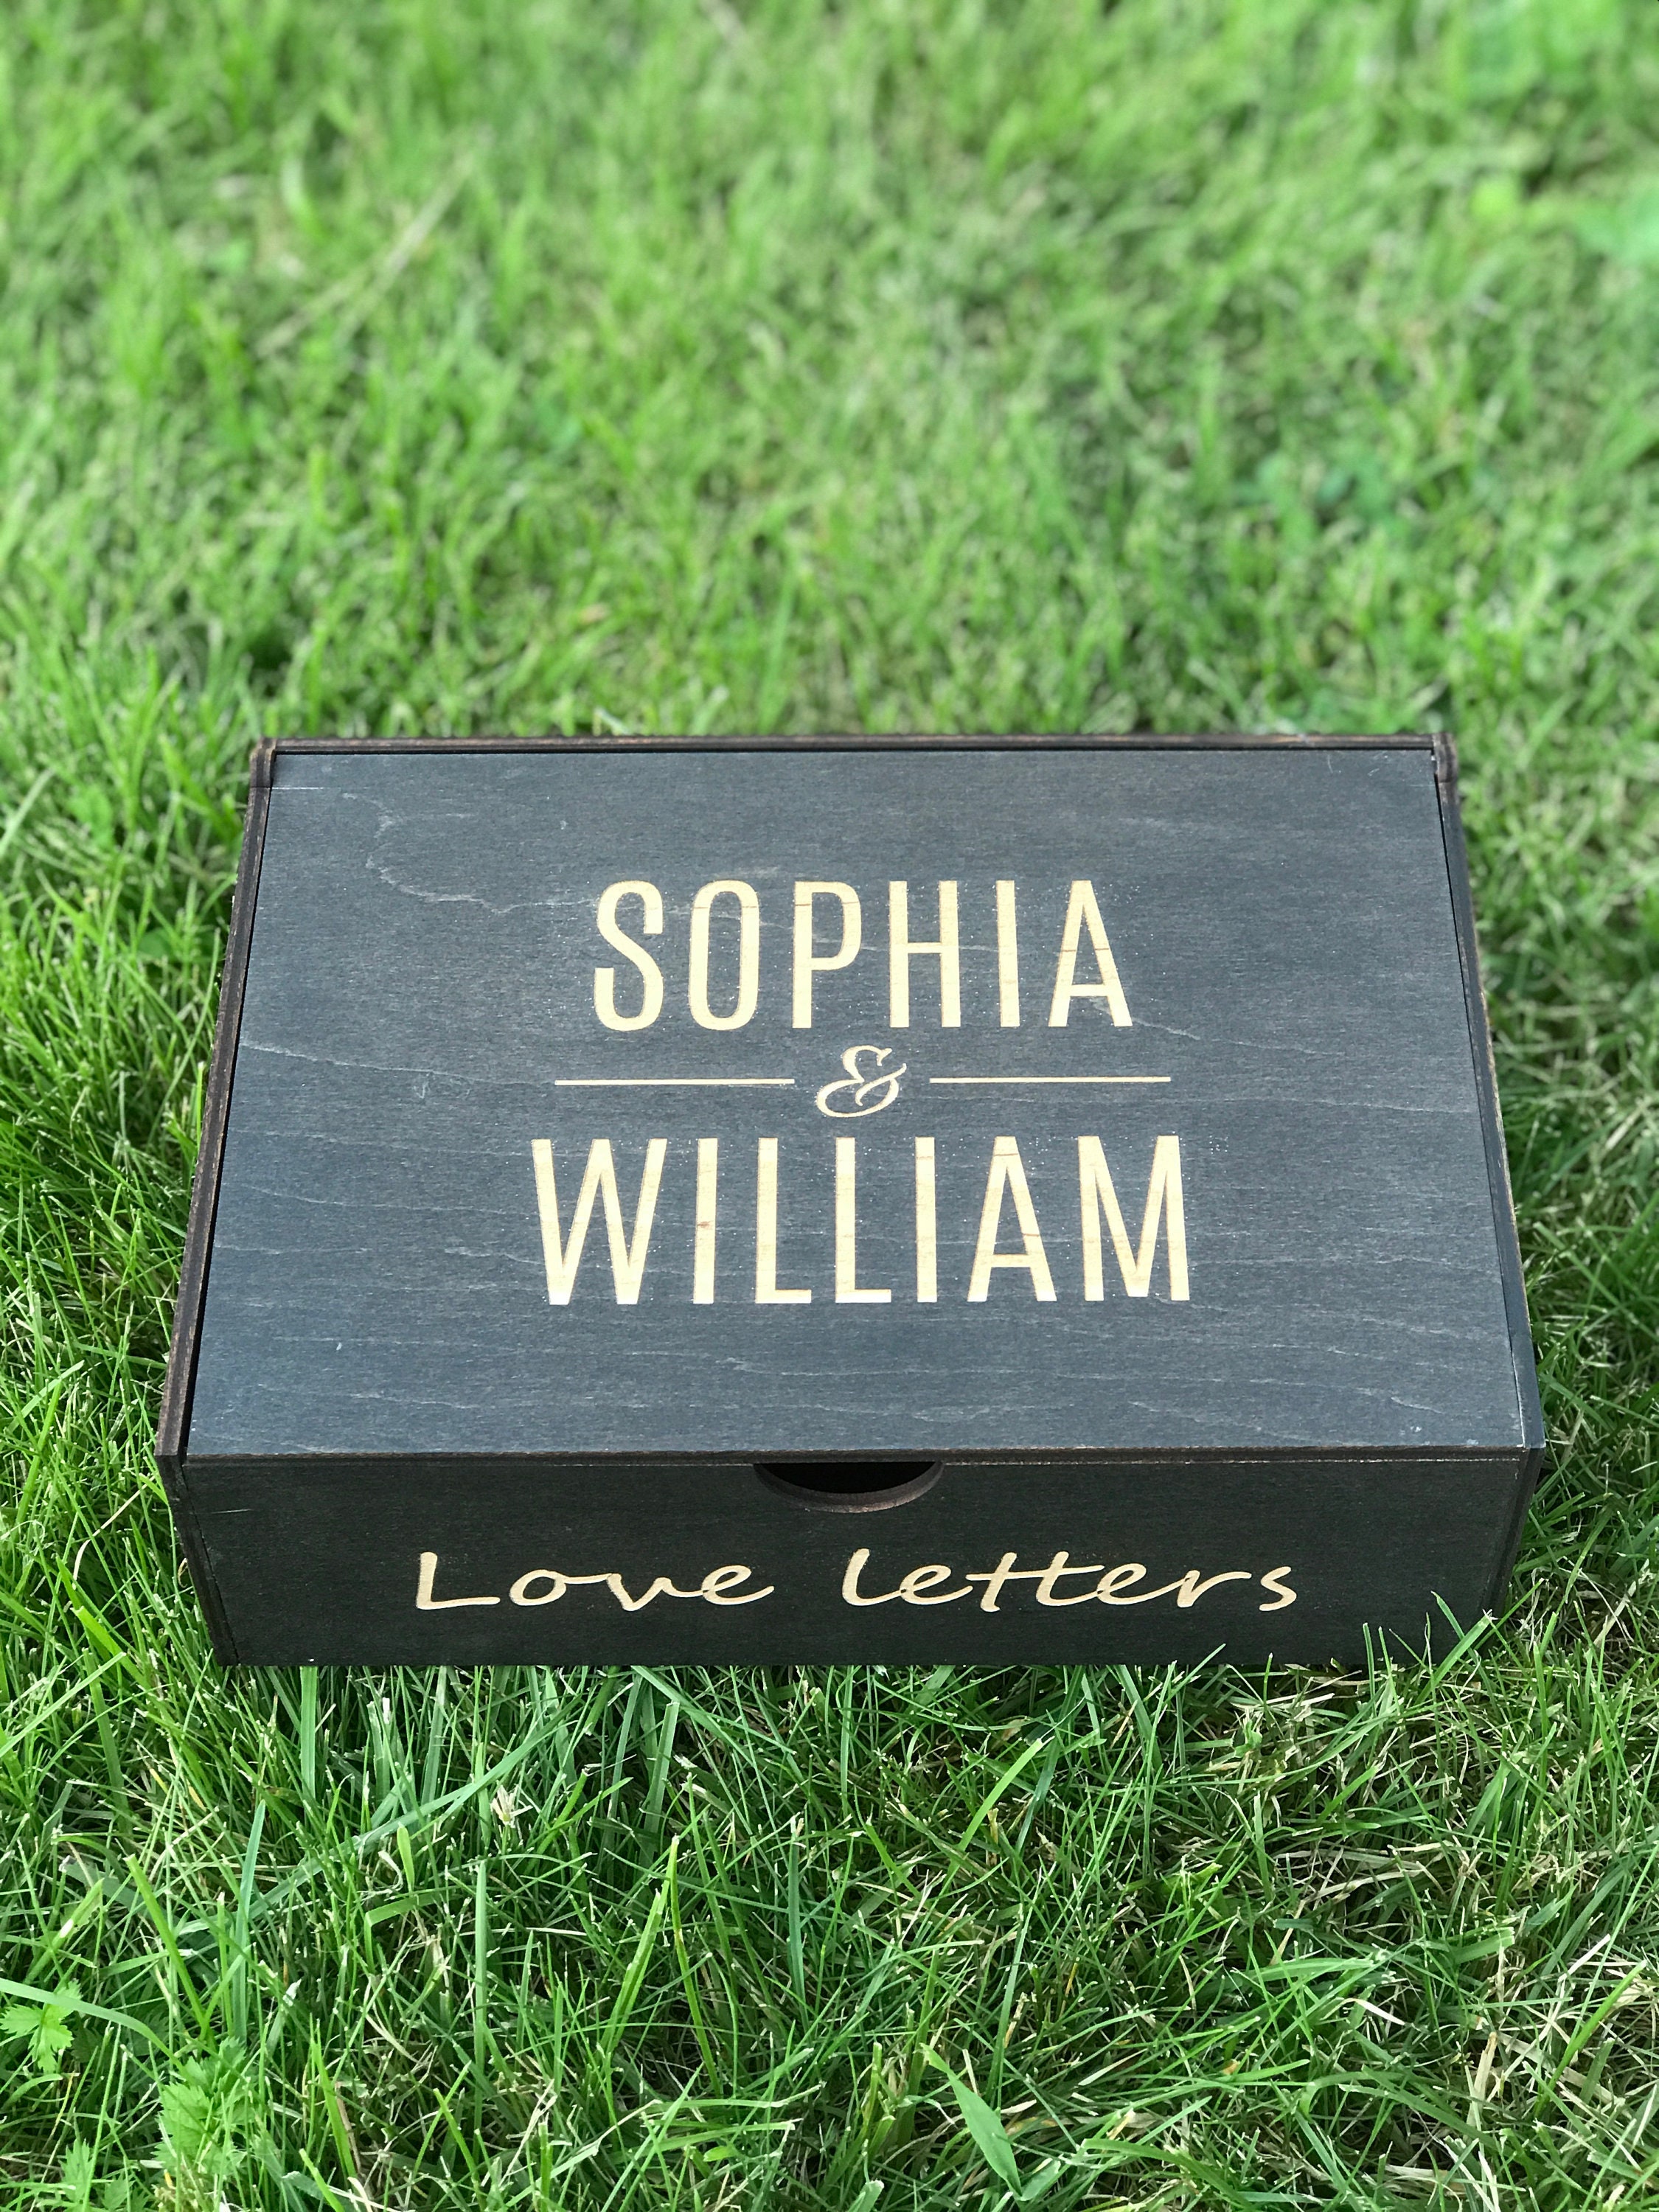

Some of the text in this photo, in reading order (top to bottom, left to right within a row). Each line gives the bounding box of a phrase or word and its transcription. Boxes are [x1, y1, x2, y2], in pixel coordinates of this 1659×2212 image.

[594, 880, 1133, 1032] SOPHIA
[815, 1045, 906, 1119] &
[531, 1135, 1190, 1304] WILLIAM
[416, 1548, 1298, 1612] Love letters
